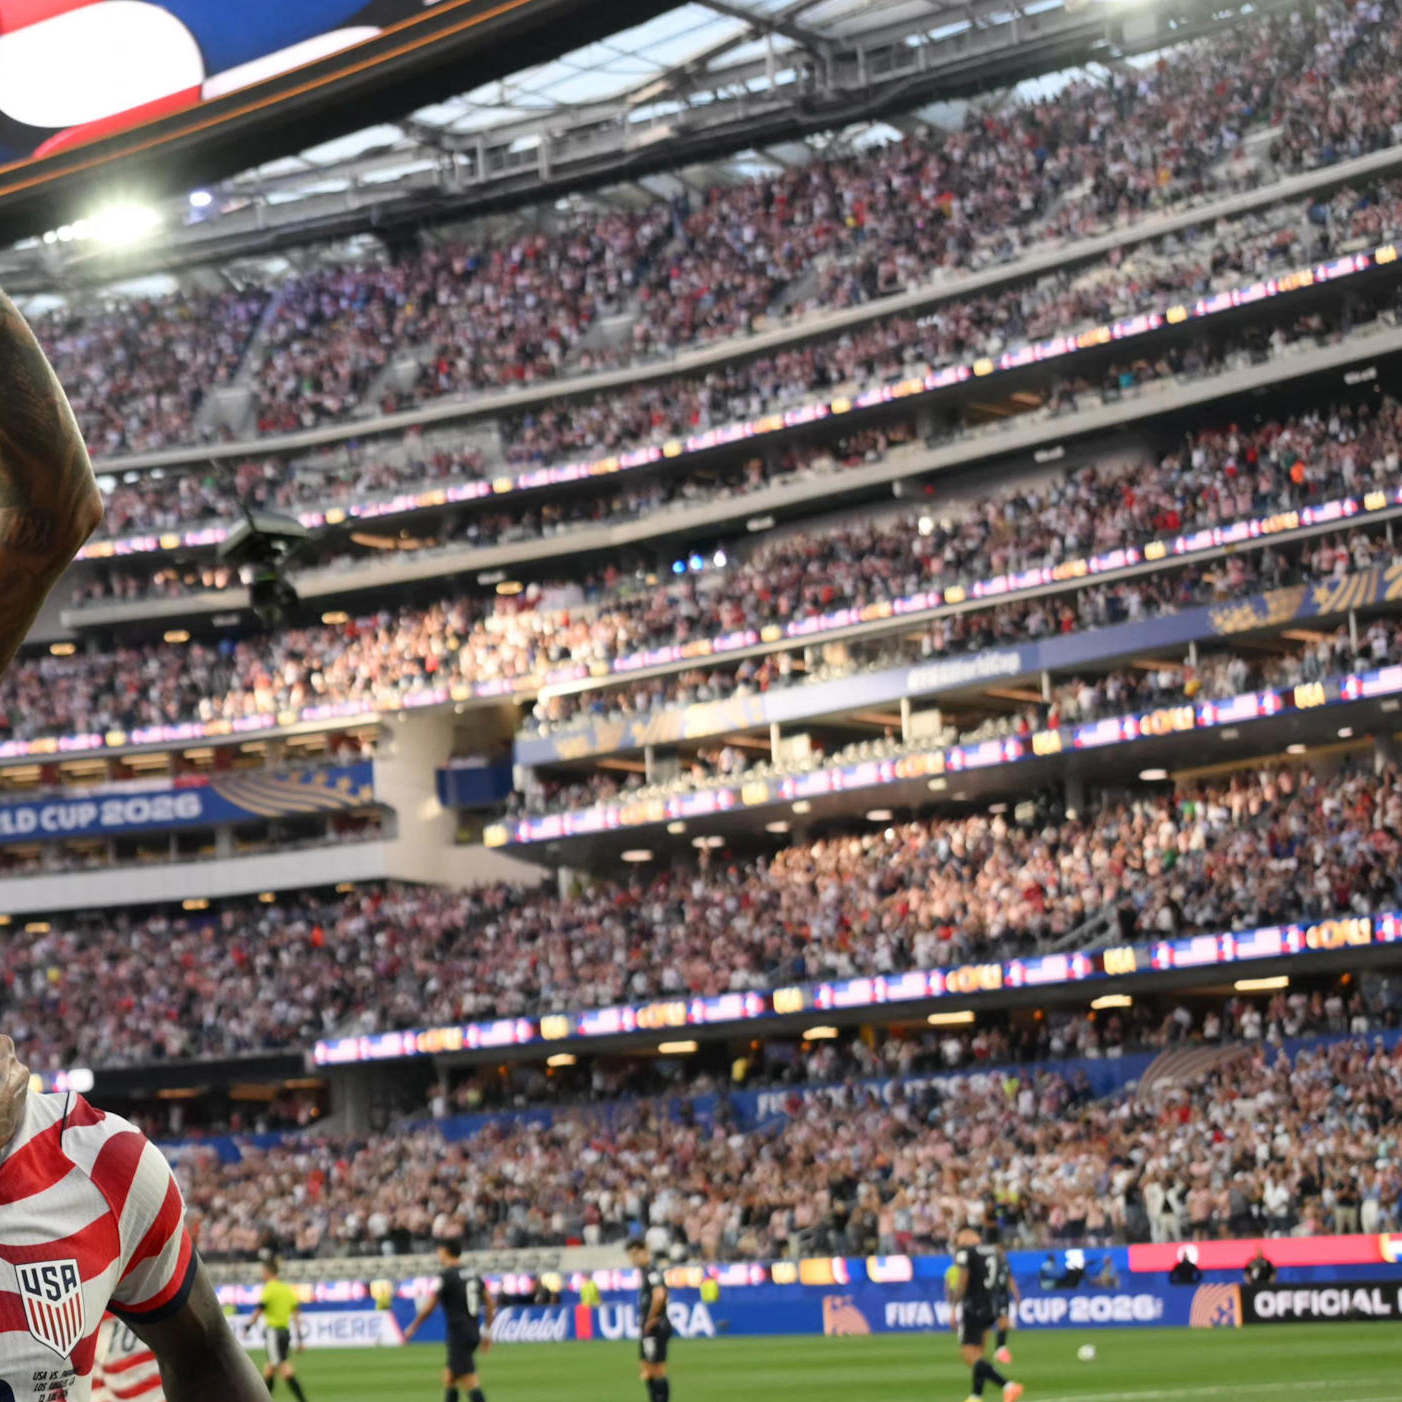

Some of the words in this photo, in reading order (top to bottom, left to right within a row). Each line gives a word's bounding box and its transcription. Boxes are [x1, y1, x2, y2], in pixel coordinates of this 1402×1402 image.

[40, 800, 96, 831] CUP
[100, 792, 202, 825] 2026
[20, 1263, 78, 1303] USA
[885, 1302, 935, 1327] FIFA
[1018, 1298, 1067, 1324] CUP
[1069, 1294, 1154, 1323] 2026
[1254, 1287, 1392, 1319] OFFICIAL
[318, 1315, 383, 1340] HERE
[599, 1303, 716, 1337] ULRA
[33, 1370, 47, 1381] USA
[33, 1382, 46, 1392] LOS
